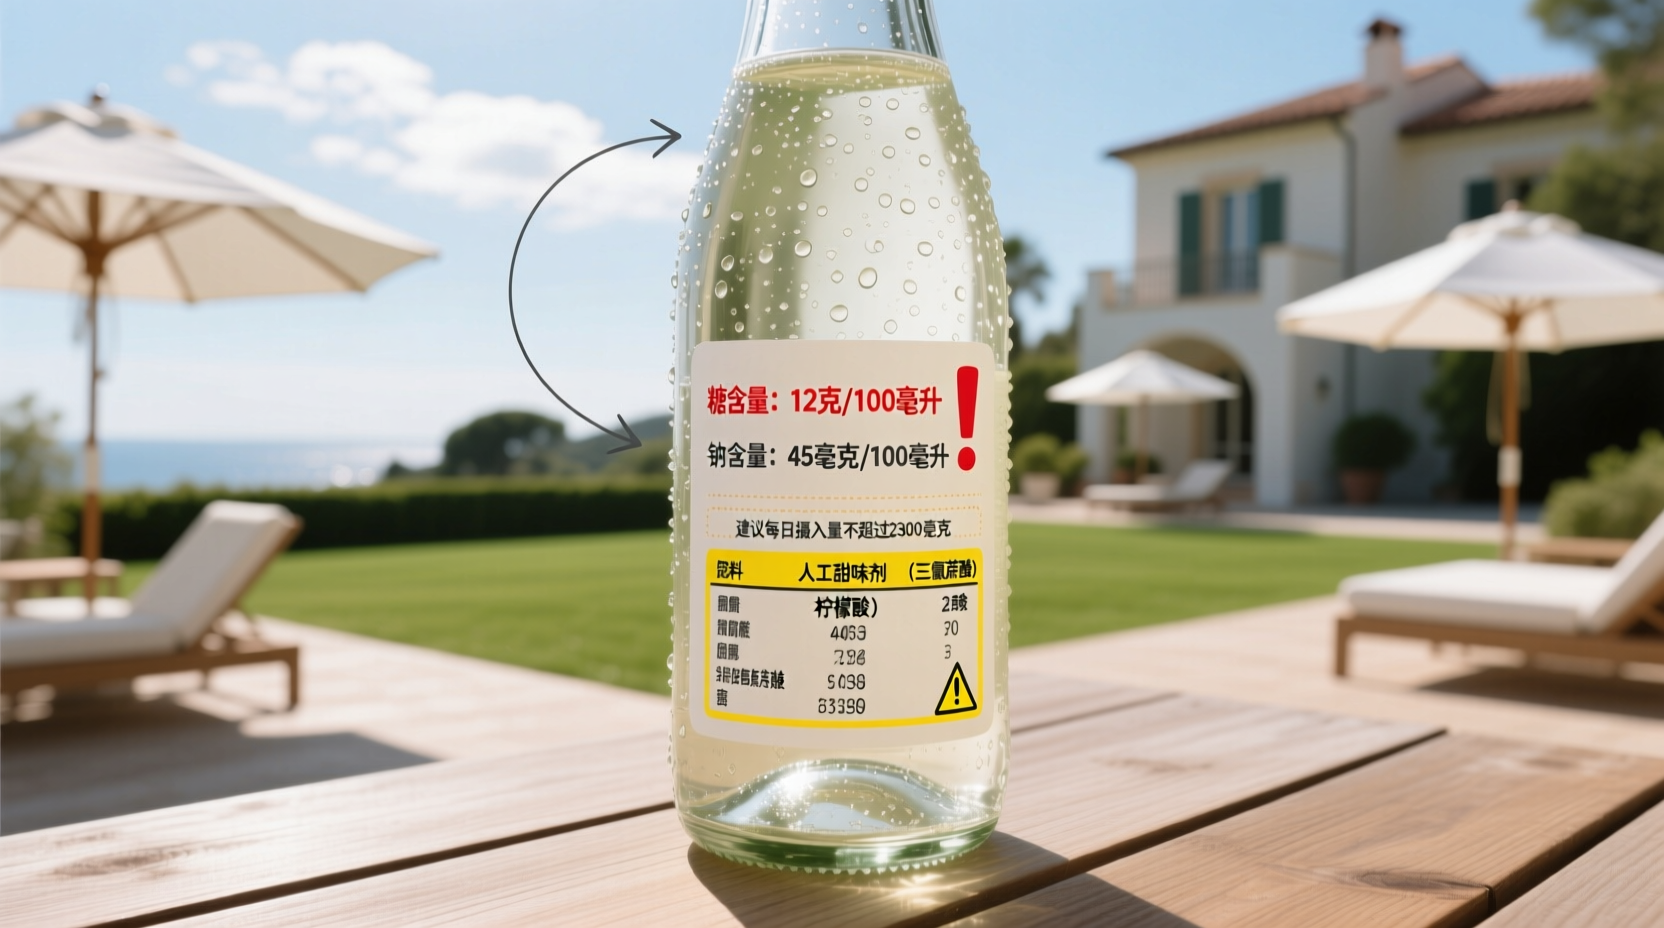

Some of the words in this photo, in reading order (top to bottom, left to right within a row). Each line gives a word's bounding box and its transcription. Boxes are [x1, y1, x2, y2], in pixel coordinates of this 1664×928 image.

[707, 384, 943, 416] 糖含量：12克/100毫升
[707, 441, 950, 471] 钠含量：45毫克/100毫升
[798, 562, 887, 584] 人工甜味剂
